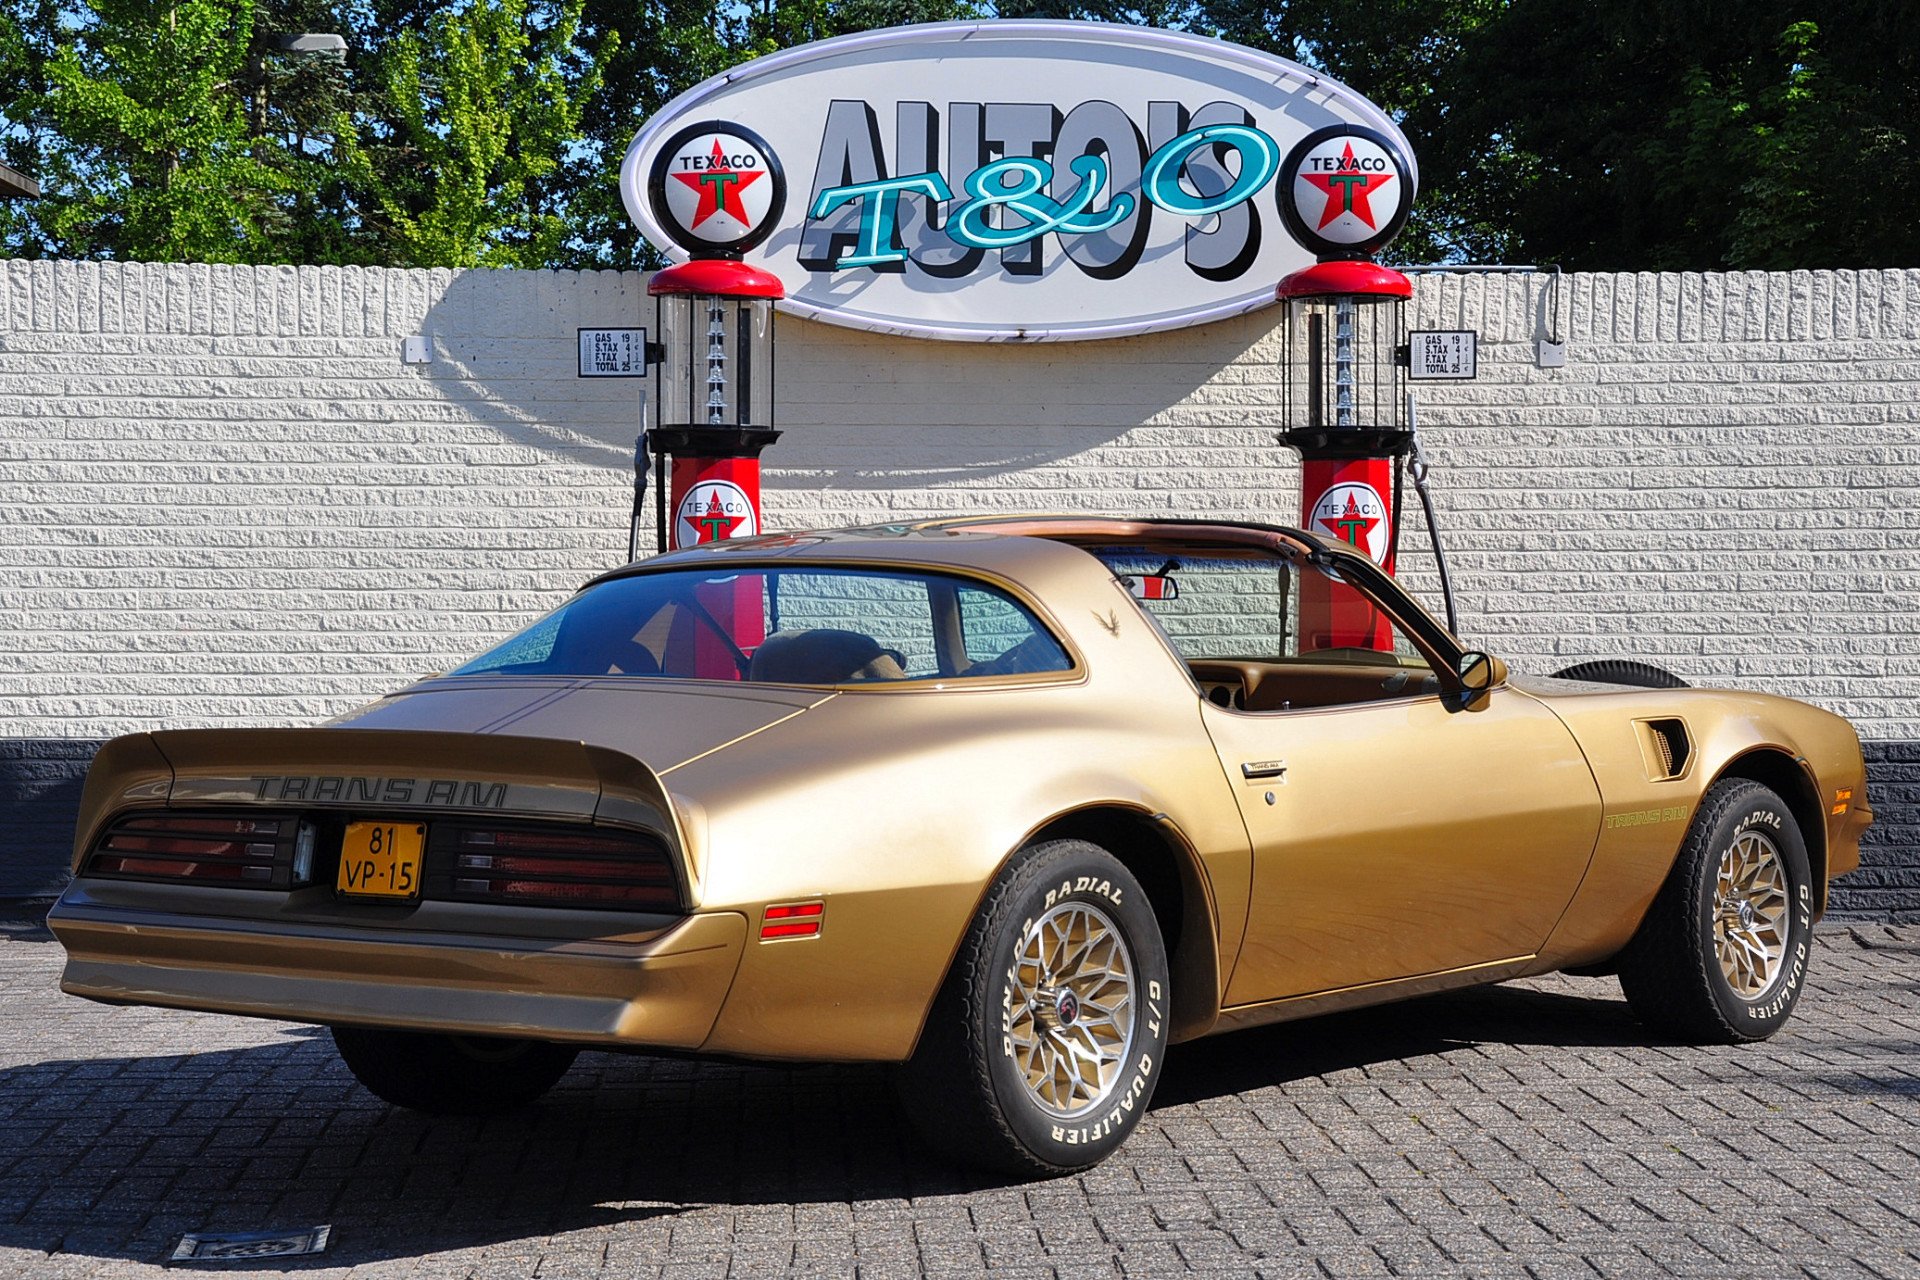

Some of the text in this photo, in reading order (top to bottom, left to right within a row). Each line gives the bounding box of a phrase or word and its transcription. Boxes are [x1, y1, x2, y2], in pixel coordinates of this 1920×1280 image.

[680, 154, 756, 170] TEXACO
[1310, 157, 1386, 171] TEXACO
[797, 99, 1262, 282] AUTO'S
[595, 333, 611, 342] GAS
[621, 333, 630, 342] 19
[1425, 335, 1442, 344] GAS
[1451, 335, 1460, 344] 19
[595, 343, 618, 352] S.TAX
[625, 344, 630, 352] 4
[1425, 345, 1448, 354] S.TAX
[1455, 345, 1460, 353] 4
[595, 353, 617, 361] F.TAX
[1425, 355, 1447, 363] F.TAX
[595, 362, 619, 372] TOTAL
[622, 363, 631, 372] 25
[1425, 364, 1449, 373] TOTAL
[1451, 364, 1460, 373] 25
[687, 502, 743, 513] TEXACO
[1322, 504, 1377, 514] TEXACO
[251, 775, 508, 807] TRANS AM
[1605, 805, 1688, 829] TRANS AM
[1733, 811, 1781, 841] RADIAL
[369, 827, 394, 856] 81
[345, 860, 412, 890] VP-15
[1045, 876, 1122, 910] RADIAL
[1748, 942, 1806, 1020] QUALIFIER
[1051, 980, 1162, 1144] G/T QUALIFIER
